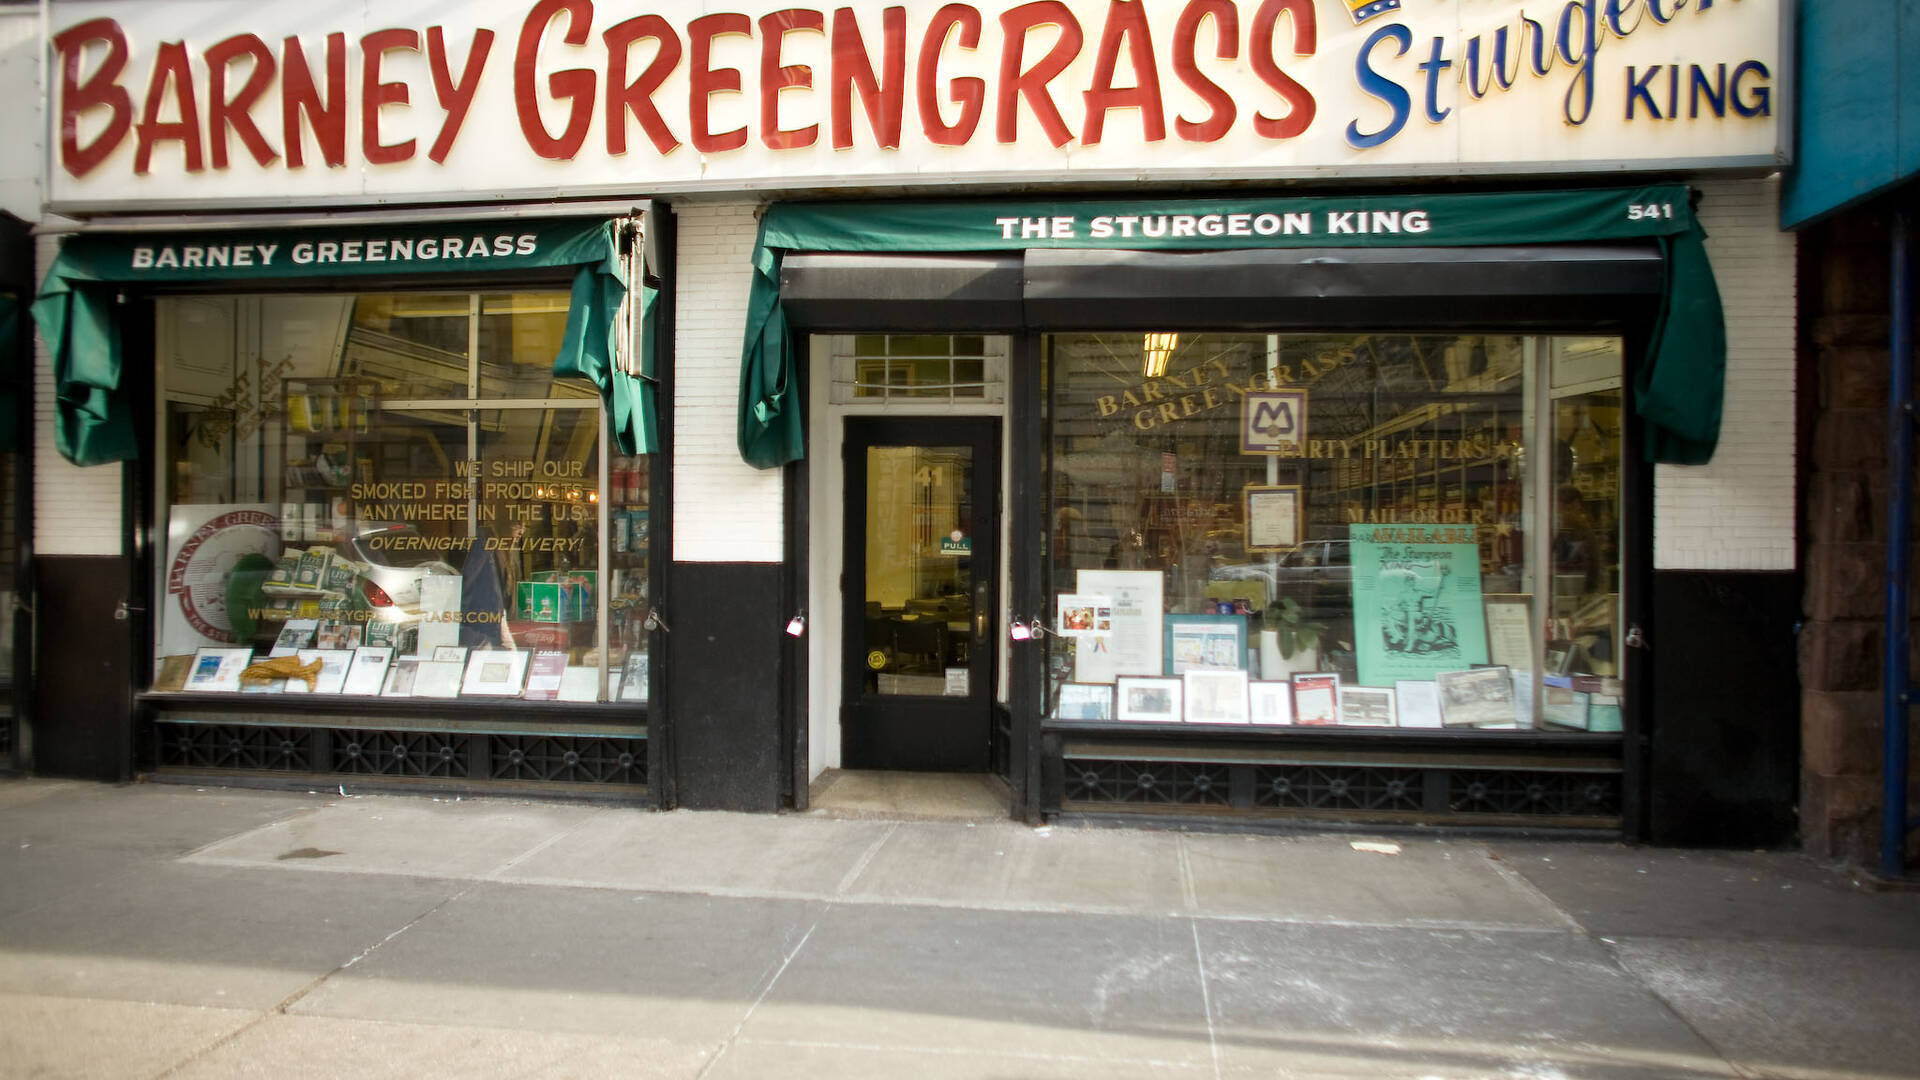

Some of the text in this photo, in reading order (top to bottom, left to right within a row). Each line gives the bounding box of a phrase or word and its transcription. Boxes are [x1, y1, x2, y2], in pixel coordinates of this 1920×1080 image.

[1344, 0, 1742, 148] Sturge
[50, 0, 1318, 180] BARNEY GREENGRASS
[1624, 60, 1772, 122] KING
[1627, 203, 1672, 221] 541
[996, 210, 1431, 239] THE STURGEON KING
[131, 234, 538, 268] BARNEY GREENGRASS
[1097, 359, 1230, 418] BARNEY
[1365, 439, 1486, 459] PLATTERS
[455, 461, 583, 477] WE SHIP OUR
[351, 483, 583, 499] SMOKED FISH PRODUCTS
[360, 504, 468, 521] ANYWHERE
[478, 504, 496, 521] IN
[505, 504, 543, 521] THE
[369, 537, 585, 552] OVERNIGHT DELIVERY!
[943, 542, 969, 550] PULL
